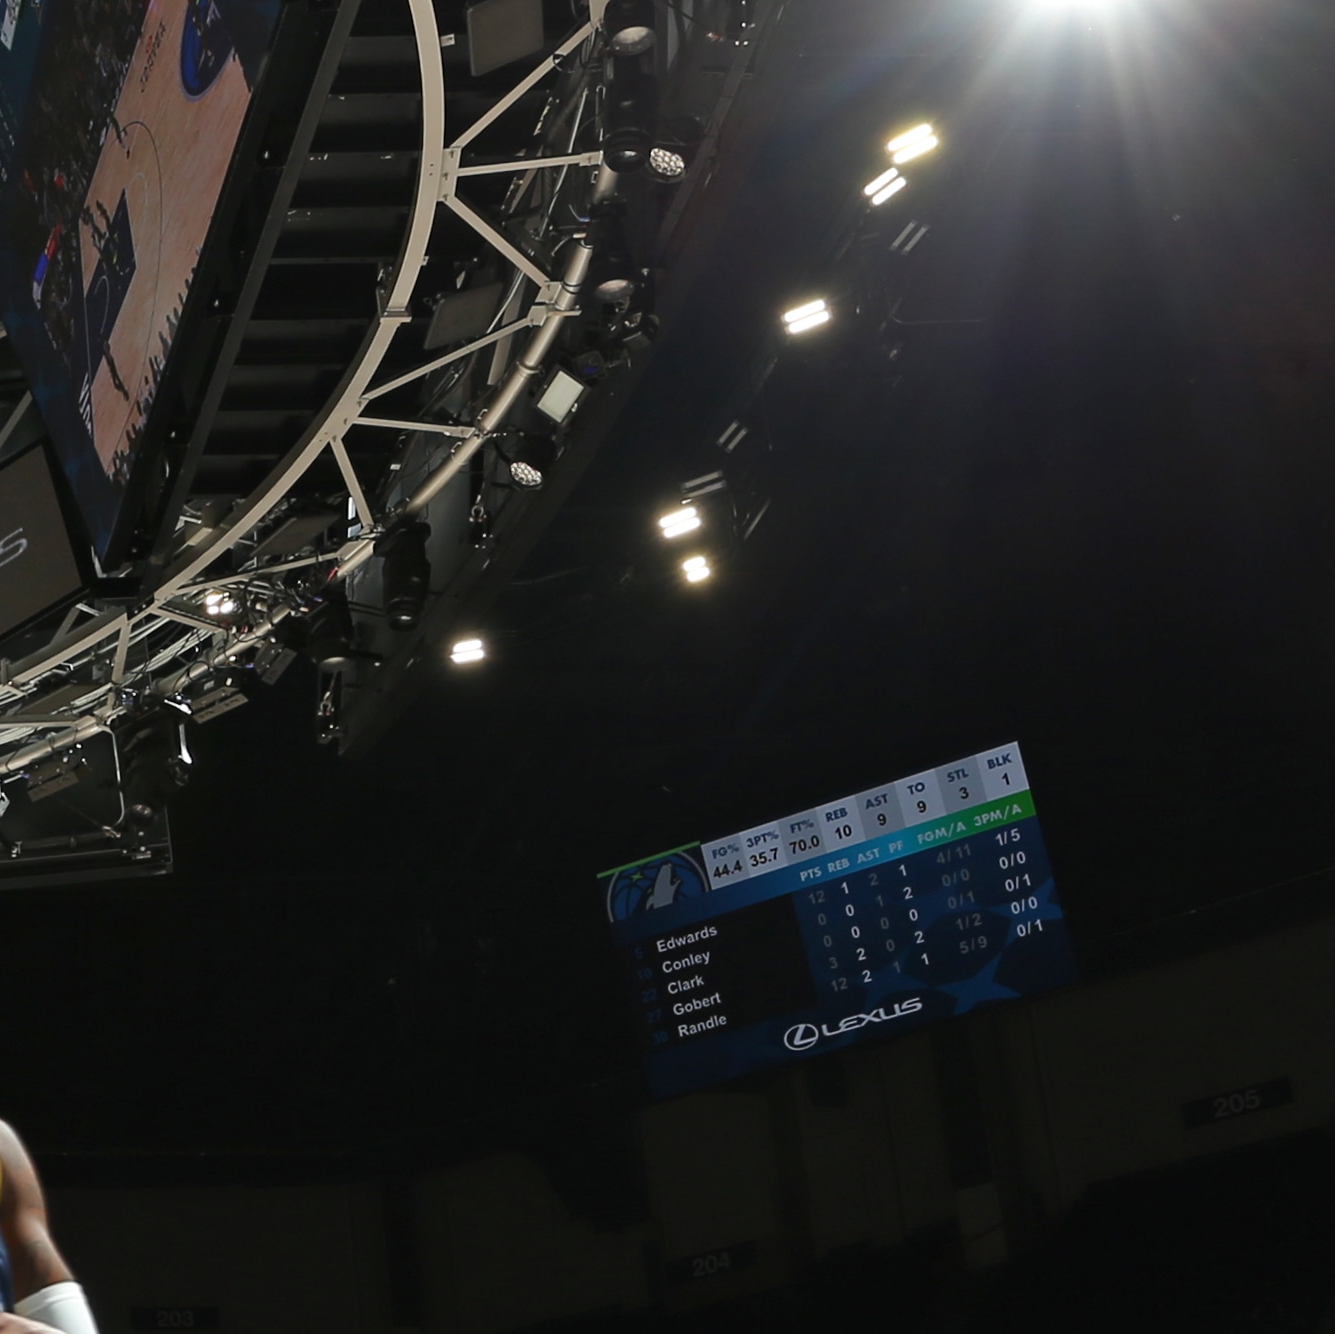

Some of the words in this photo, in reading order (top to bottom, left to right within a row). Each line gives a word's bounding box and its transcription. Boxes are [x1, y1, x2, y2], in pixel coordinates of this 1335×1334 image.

[711, 843, 739, 859] FG%
[746, 830, 779, 850] 3PT%
[789, 819, 813, 835] FT%
[824, 807, 847, 822] REB
[865, 793, 889, 810] AST
[907, 781, 926, 795] TO
[946, 767, 968, 784] STL
[986, 753, 1012, 769] BLK
[713, 860, 742, 880] 44.4
[749, 847, 780, 868] 35.7
[789, 835, 820, 855] 70.0
[835, 824, 852, 840] 10
[877, 813, 887, 826] 9
[917, 800, 927, 814] 9
[959, 786, 969, 800] 3
[1002, 773, 1010, 786] 1
[800, 865, 822, 882] PTS
[828, 858, 850, 874] REB
[857, 848, 880, 865] AST
[889, 840, 904, 853] PF
[917, 822, 966, 845] FGM/A
[974, 803, 1022, 827] 3PM/A
[656, 923, 717, 953] Edwards
[995, 829, 1020, 845] 1/5
[662, 950, 711, 975] Conley
[999, 852, 1026, 868] 0/0
[667, 974, 704, 995] Clark
[1005, 874, 1031, 890] 0/1
[673, 992, 721, 1017] Gobert
[1011, 896, 1037, 913] 0/0
[678, 1012, 727, 1038] Randle
[1017, 920, 1043, 937] 0/1
[822, 998, 923, 1037] LEXUS
